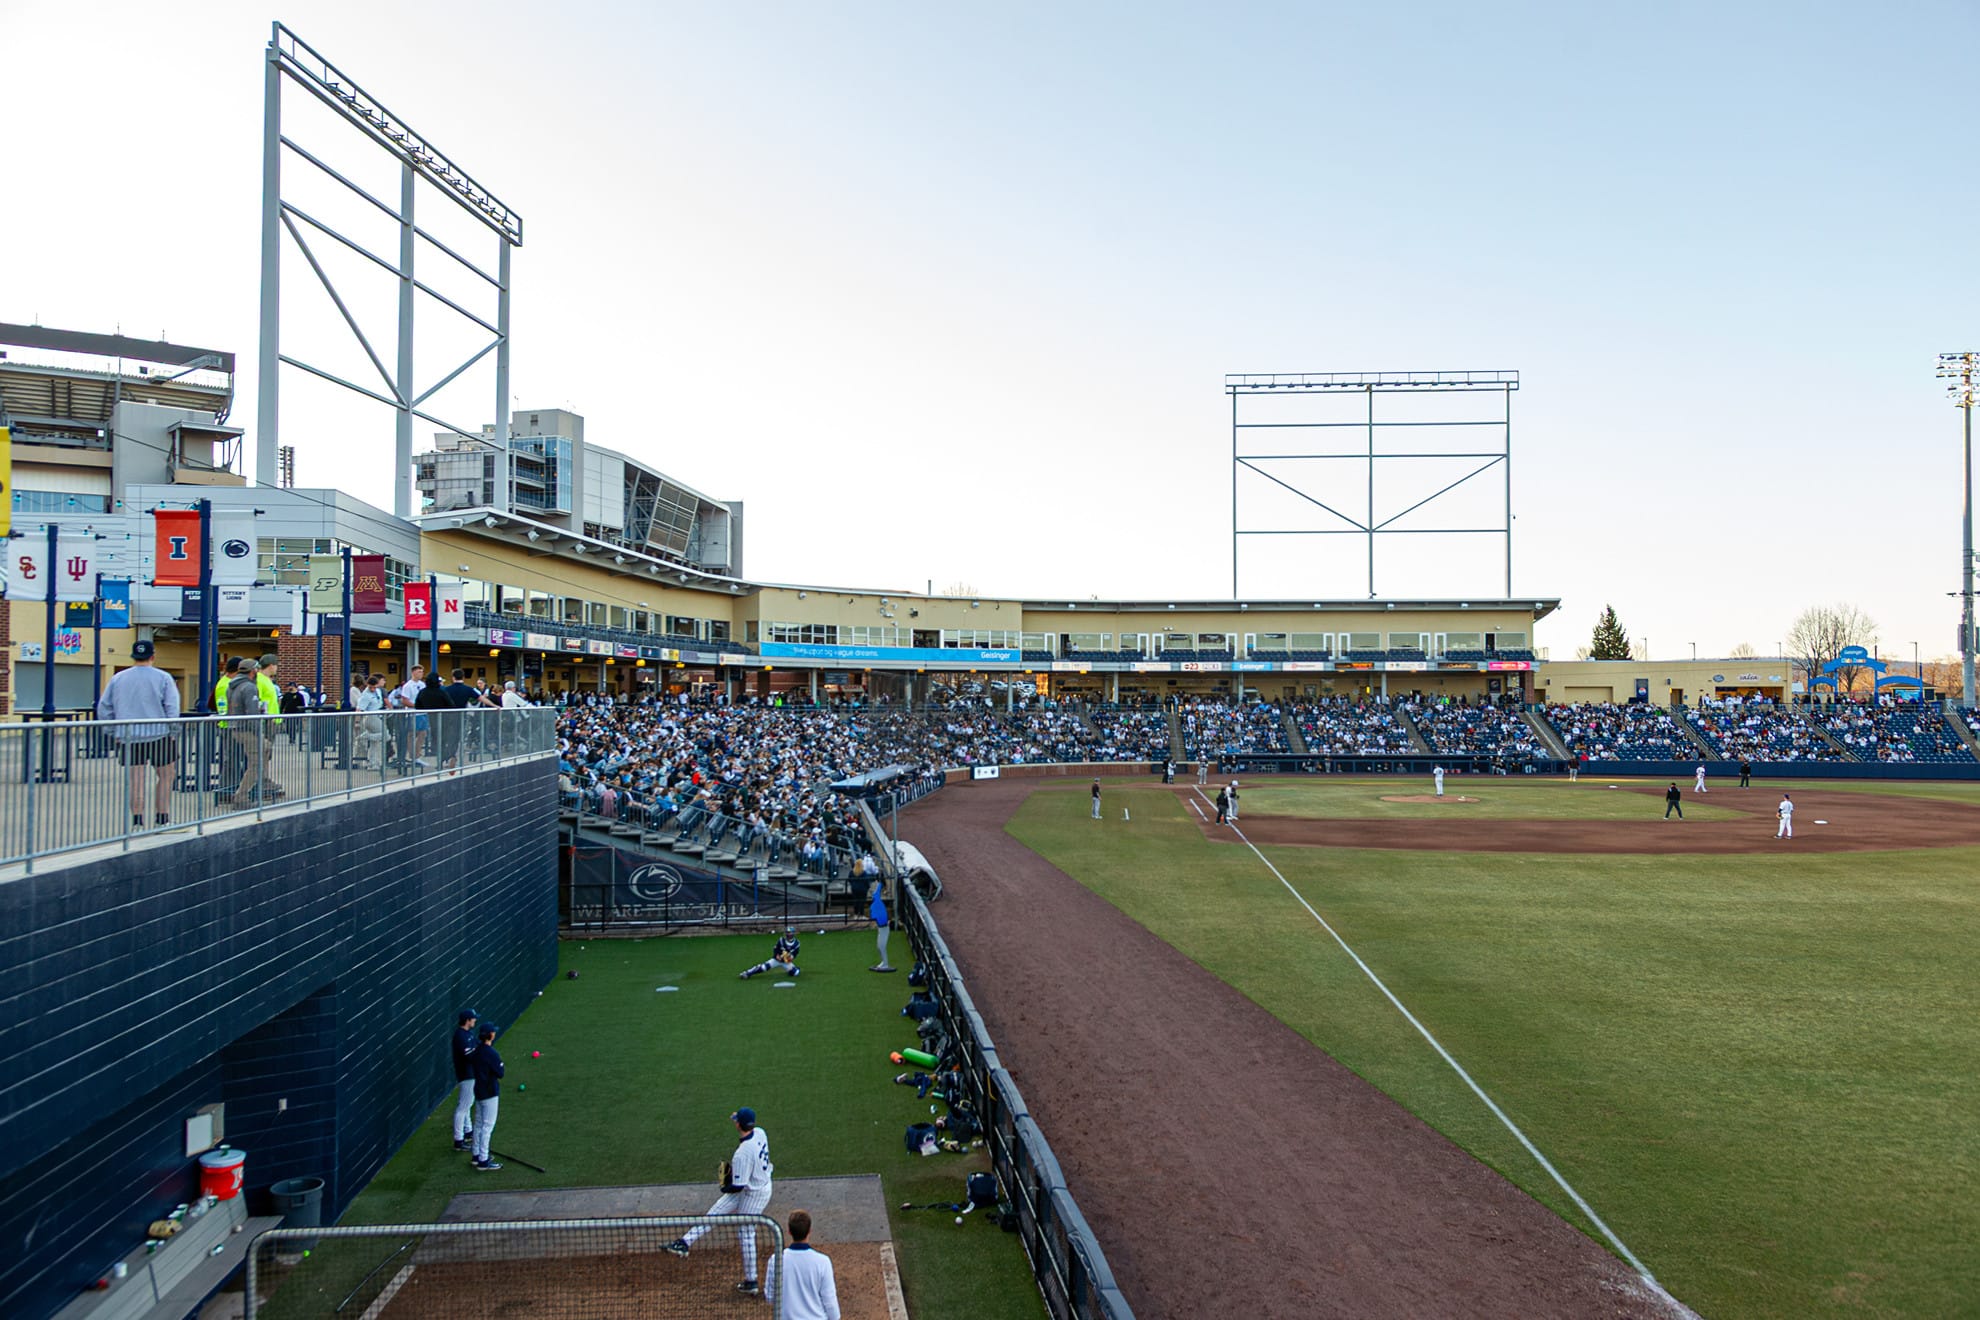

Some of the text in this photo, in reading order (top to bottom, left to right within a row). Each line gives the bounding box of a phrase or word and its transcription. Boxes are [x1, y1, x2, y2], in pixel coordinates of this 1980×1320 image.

[169, 536, 188, 560] I
[313, 577, 339, 592] P
[354, 575, 383, 593] M
[408, 598, 427, 615] R
[444, 599, 459, 613] N
[981, 651, 1011, 661] Geisinger
[612, 903, 642, 918] ARE
